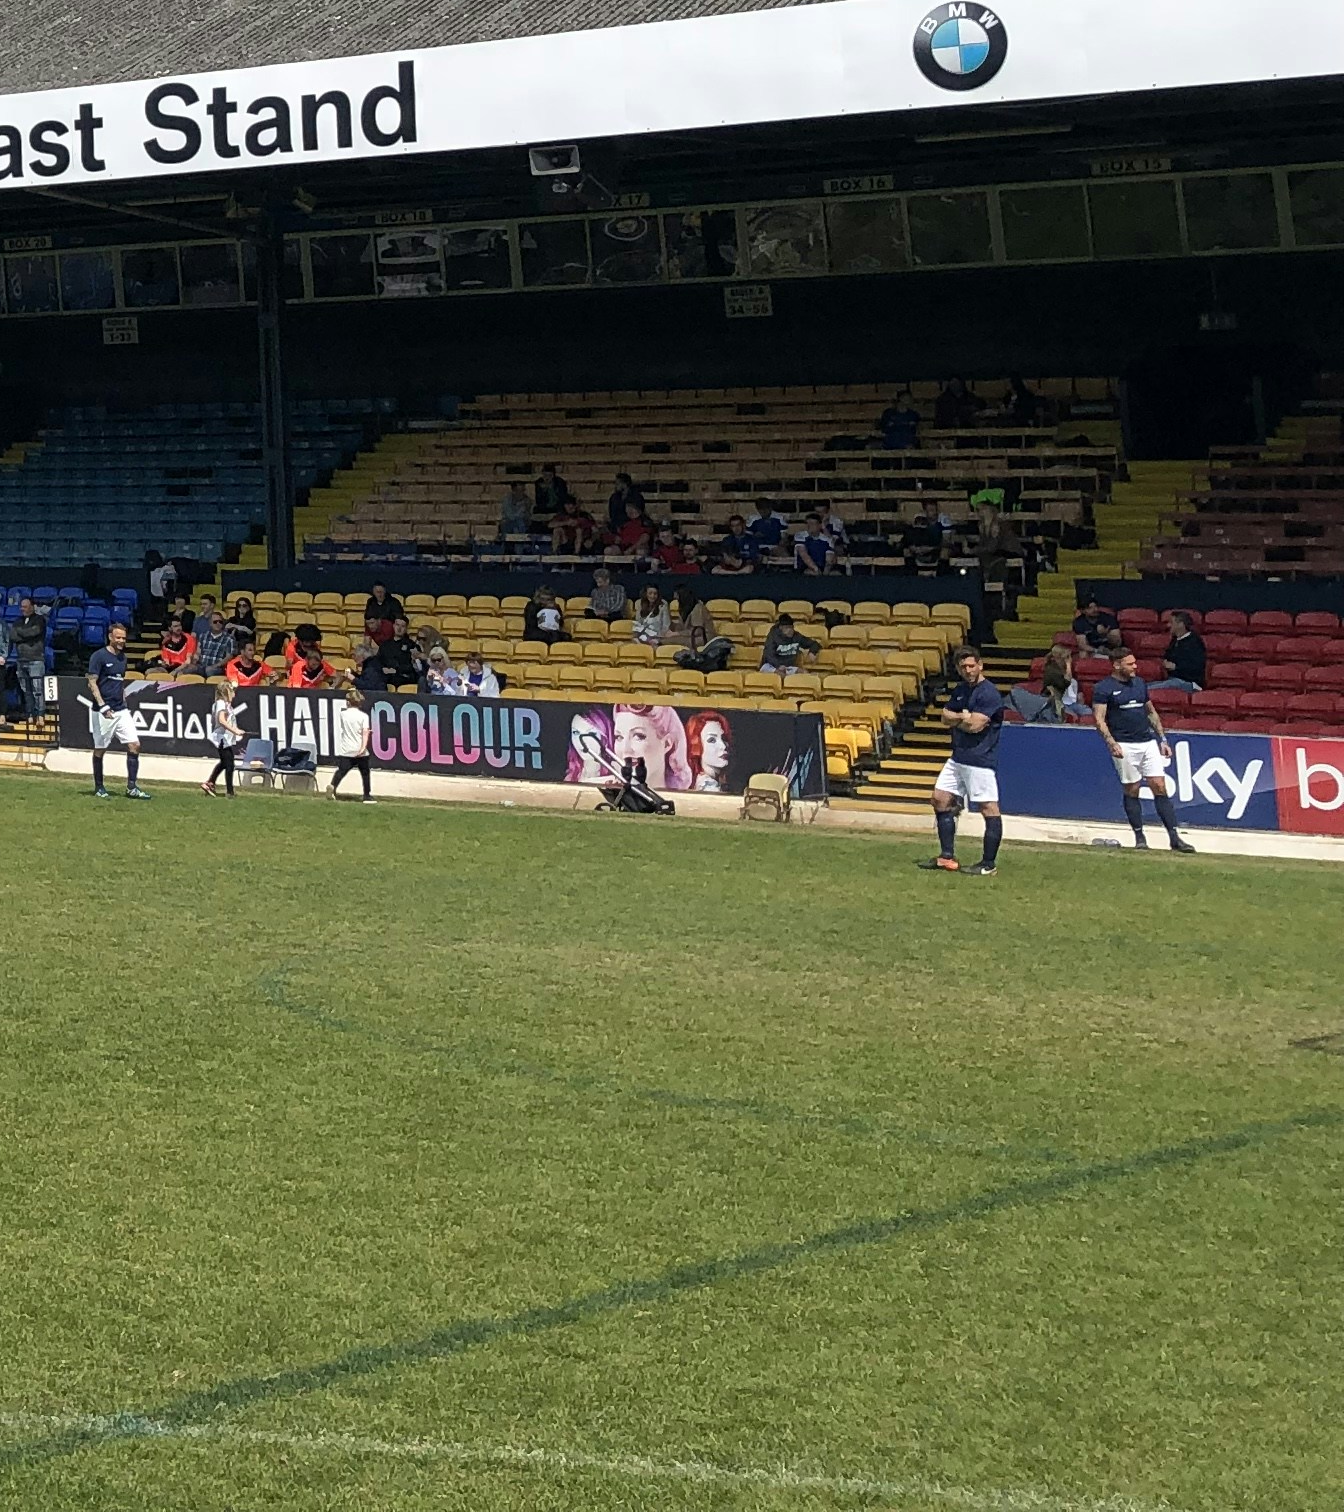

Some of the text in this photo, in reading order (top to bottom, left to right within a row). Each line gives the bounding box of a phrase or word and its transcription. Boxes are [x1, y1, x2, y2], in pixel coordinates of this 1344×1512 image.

[919, 2, 999, 35] BMW
[142, 60, 418, 164] Stand
[830, 177, 886, 192] BOX 16
[48, 677, 54, 688] E
[48, 689, 55, 700] 3
[370, 700, 543, 769] COLOUR
